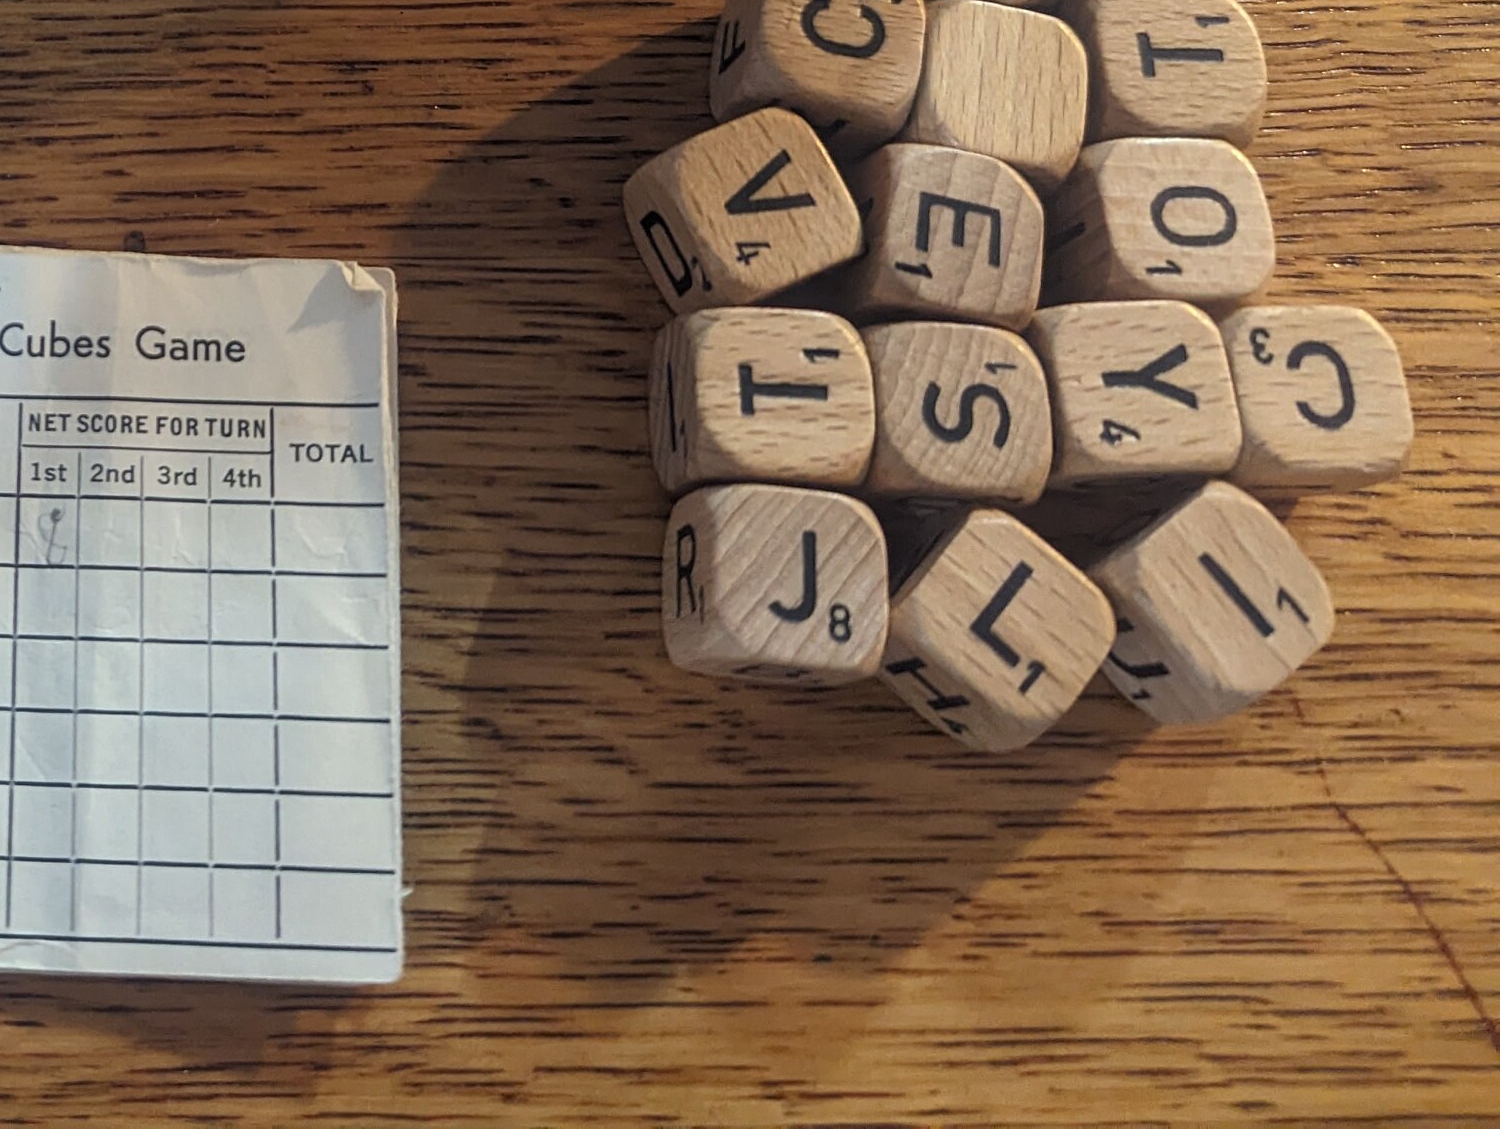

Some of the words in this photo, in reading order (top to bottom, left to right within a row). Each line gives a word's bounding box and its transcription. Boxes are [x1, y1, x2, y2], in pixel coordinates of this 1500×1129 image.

[1137, 32, 1224, 77] T
[724, 149, 816, 215] V
[916, 192, 1000, 267] E
[1150, 186, 1237, 247] O
[135, 325, 245, 363] Game
[738, 364, 828, 416] T
[1101, 343, 1198, 410] Y
[1286, 340, 1355, 430] C
[28, 413, 72, 432] NET
[77, 414, 148, 434] SCORE
[156, 416, 199, 436] FOR
[204, 418, 265, 438] TURN
[921, 380, 1011, 449] S
[31, 462, 67, 482] 1st
[90, 463, 135, 484] 2nd
[157, 466, 197, 486] 3rd
[222, 468, 261, 488] 4th
[289, 443, 374, 464] TOTAL
[676, 524, 697, 619] R
[768, 530, 817, 623] J
[829, 603, 851, 642] 8
[1198, 551, 1275, 638] I
[969, 560, 1035, 668] L
